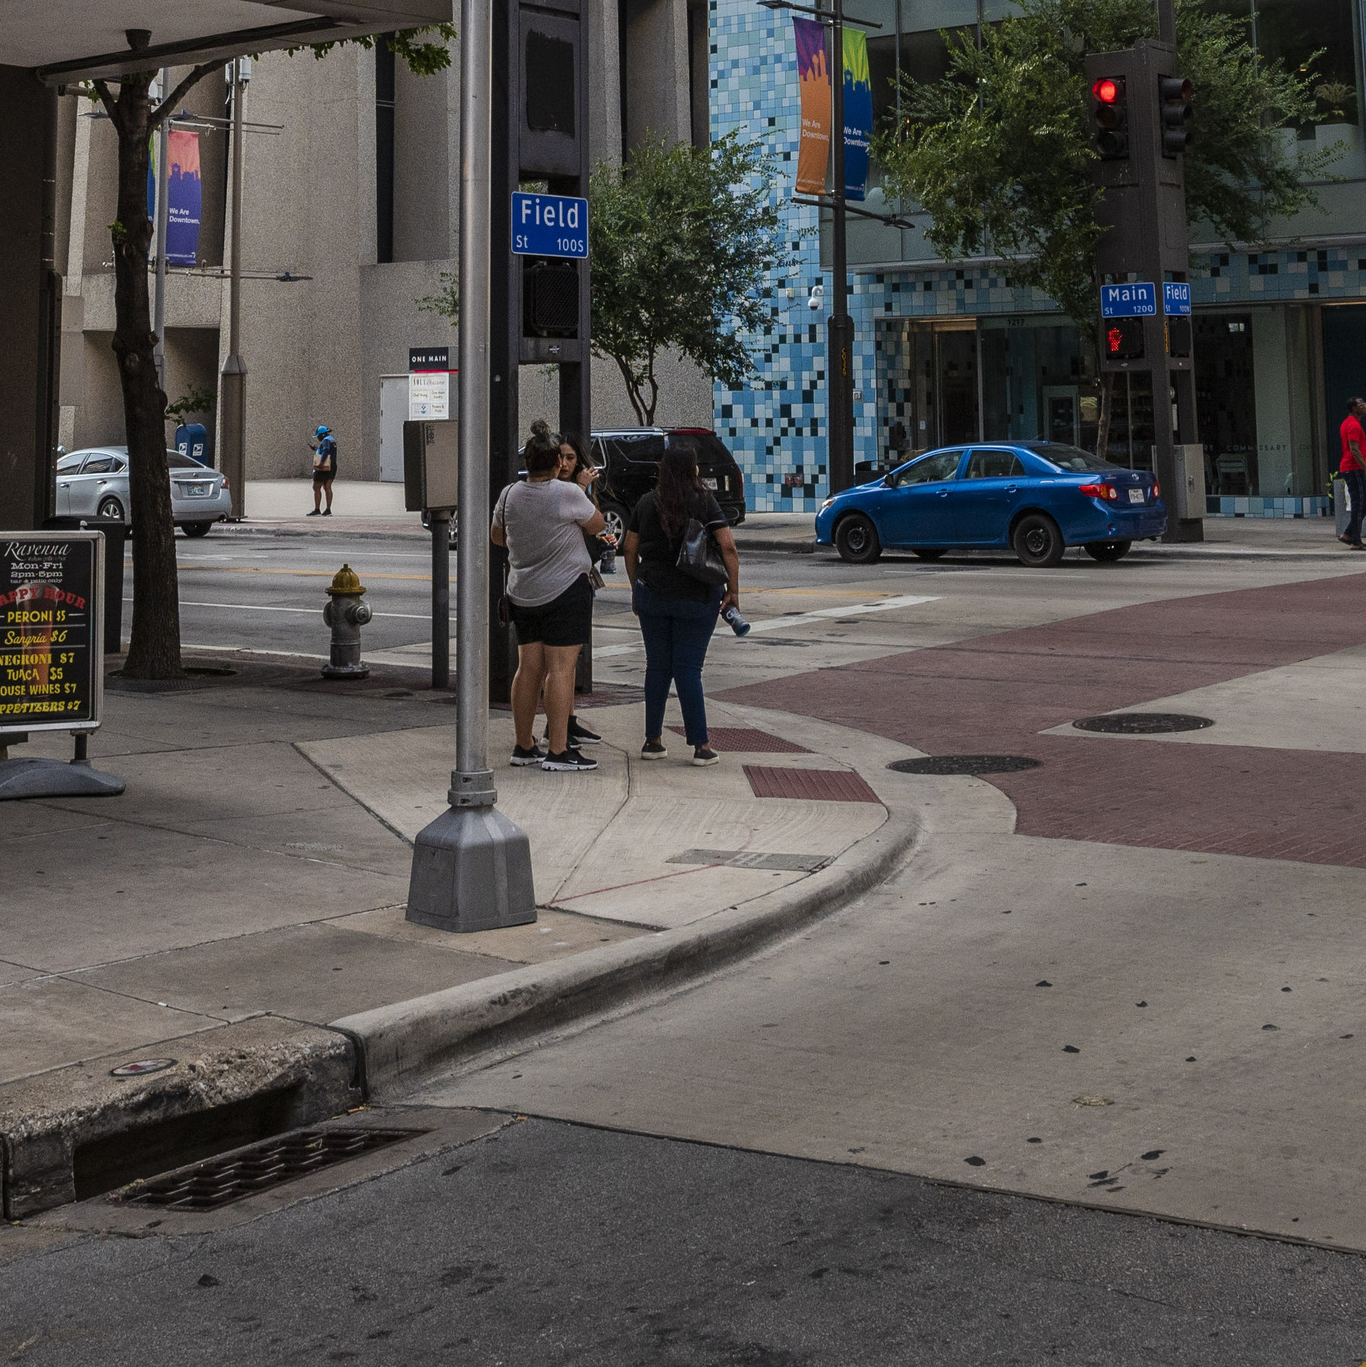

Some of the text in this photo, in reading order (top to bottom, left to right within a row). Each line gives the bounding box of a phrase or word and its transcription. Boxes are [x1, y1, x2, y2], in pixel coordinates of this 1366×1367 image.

[802, 118, 821, 129] We Are
[852, 128, 862, 136] Are
[169, 207, 190, 216] We Are
[520, 200, 581, 231] Field
[515, 235, 586, 254] St 100S
[1109, 286, 1147, 302] Main
[1166, 285, 1187, 300] Field
[1104, 304, 1153, 315] St 1200
[1165, 304, 1171, 312] St
[4, 540, 73, 562] Ravenna
[10, 562, 64, 570] Mon-Fri
[10, 570, 64, 579] 2pm-5pm
[44, 588, 87, 610] HOUR
[7, 609, 66, 623] PERONI $5
[4, 629, 68, 647] Sangria $6
[60, 652, 75, 664] $7
[7, 666, 64, 682] TUACA $5
[29, 683, 61, 696] WINES
[64, 682, 77, 694] $7
[67, 699, 82, 712] $7
